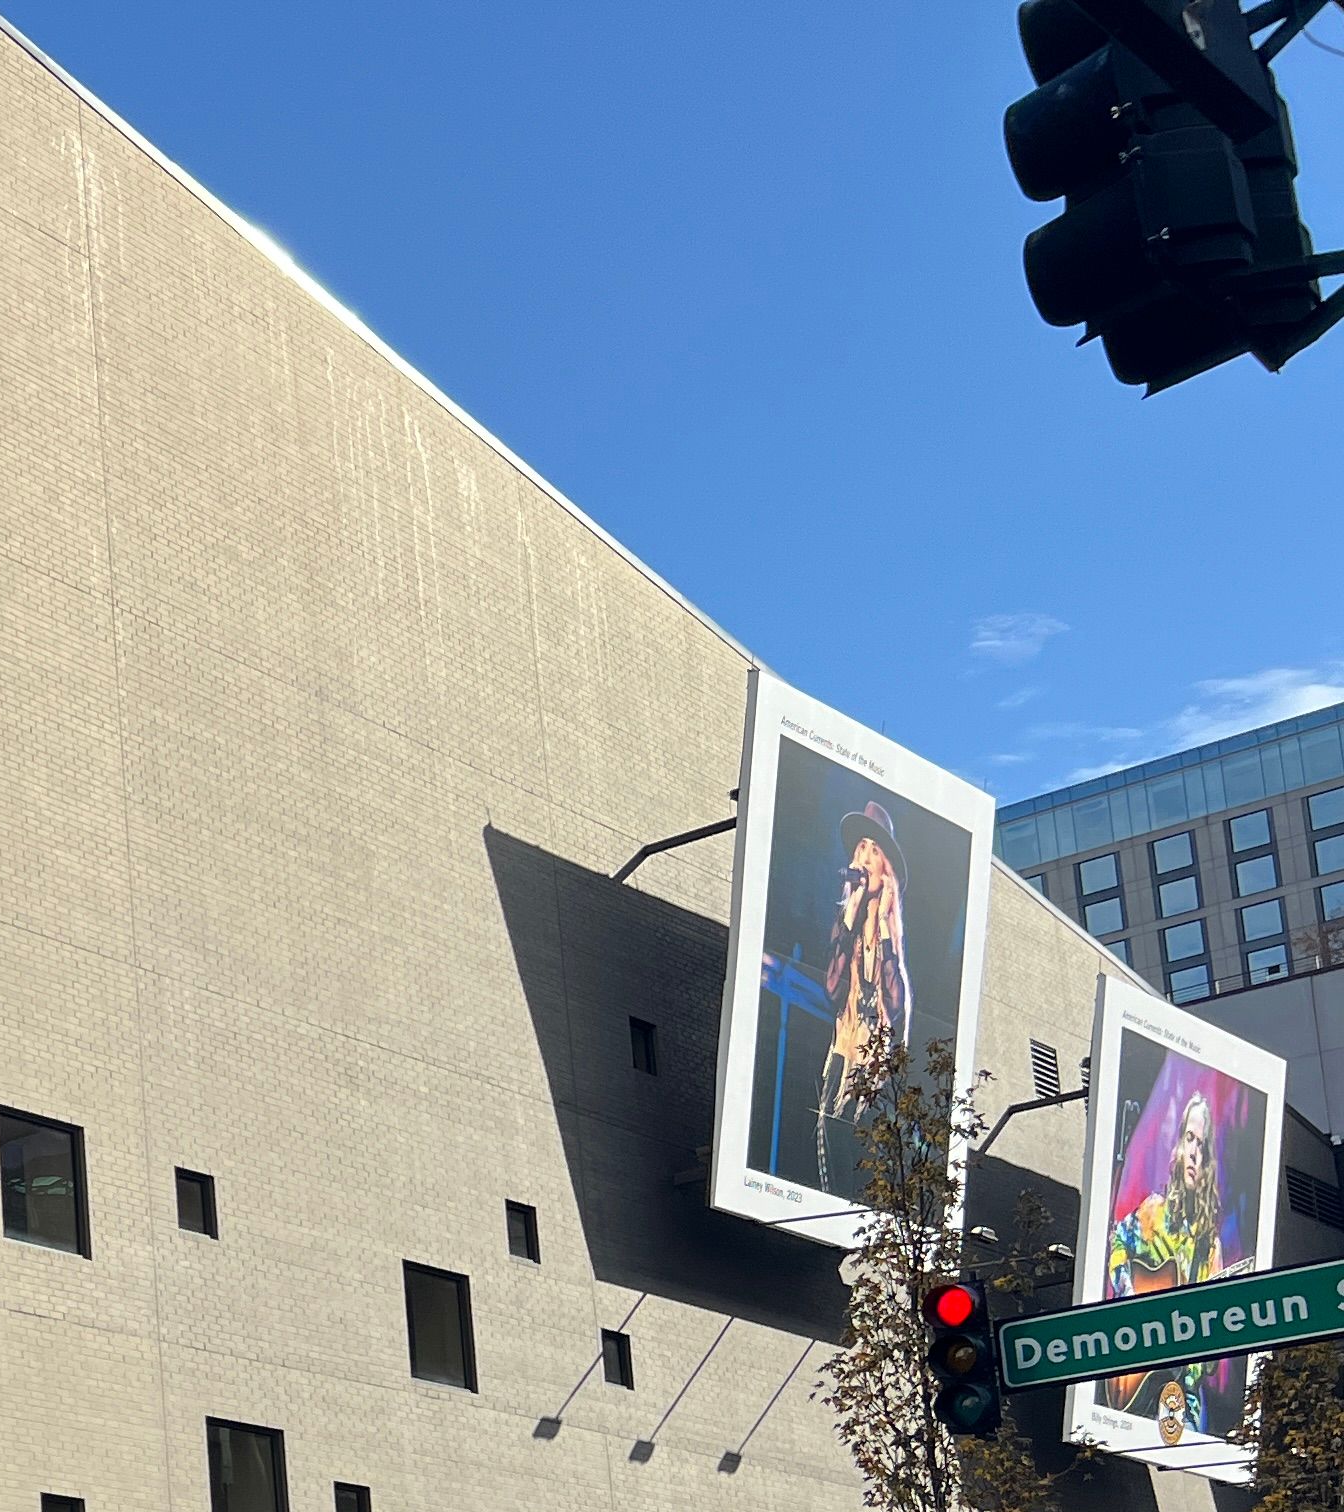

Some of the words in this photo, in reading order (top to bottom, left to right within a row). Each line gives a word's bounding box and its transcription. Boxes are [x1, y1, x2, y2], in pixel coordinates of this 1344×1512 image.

[780, 715, 808, 737] American
[835, 743, 850, 759] State
[852, 752, 858, 761] of
[858, 755, 867, 767] the
[868, 760, 885, 777] Music
[744, 1175, 763, 1192] Lainey
[786, 1189, 803, 1203] 2023
[1014, 1294, 1309, 1370] Demonbreun
